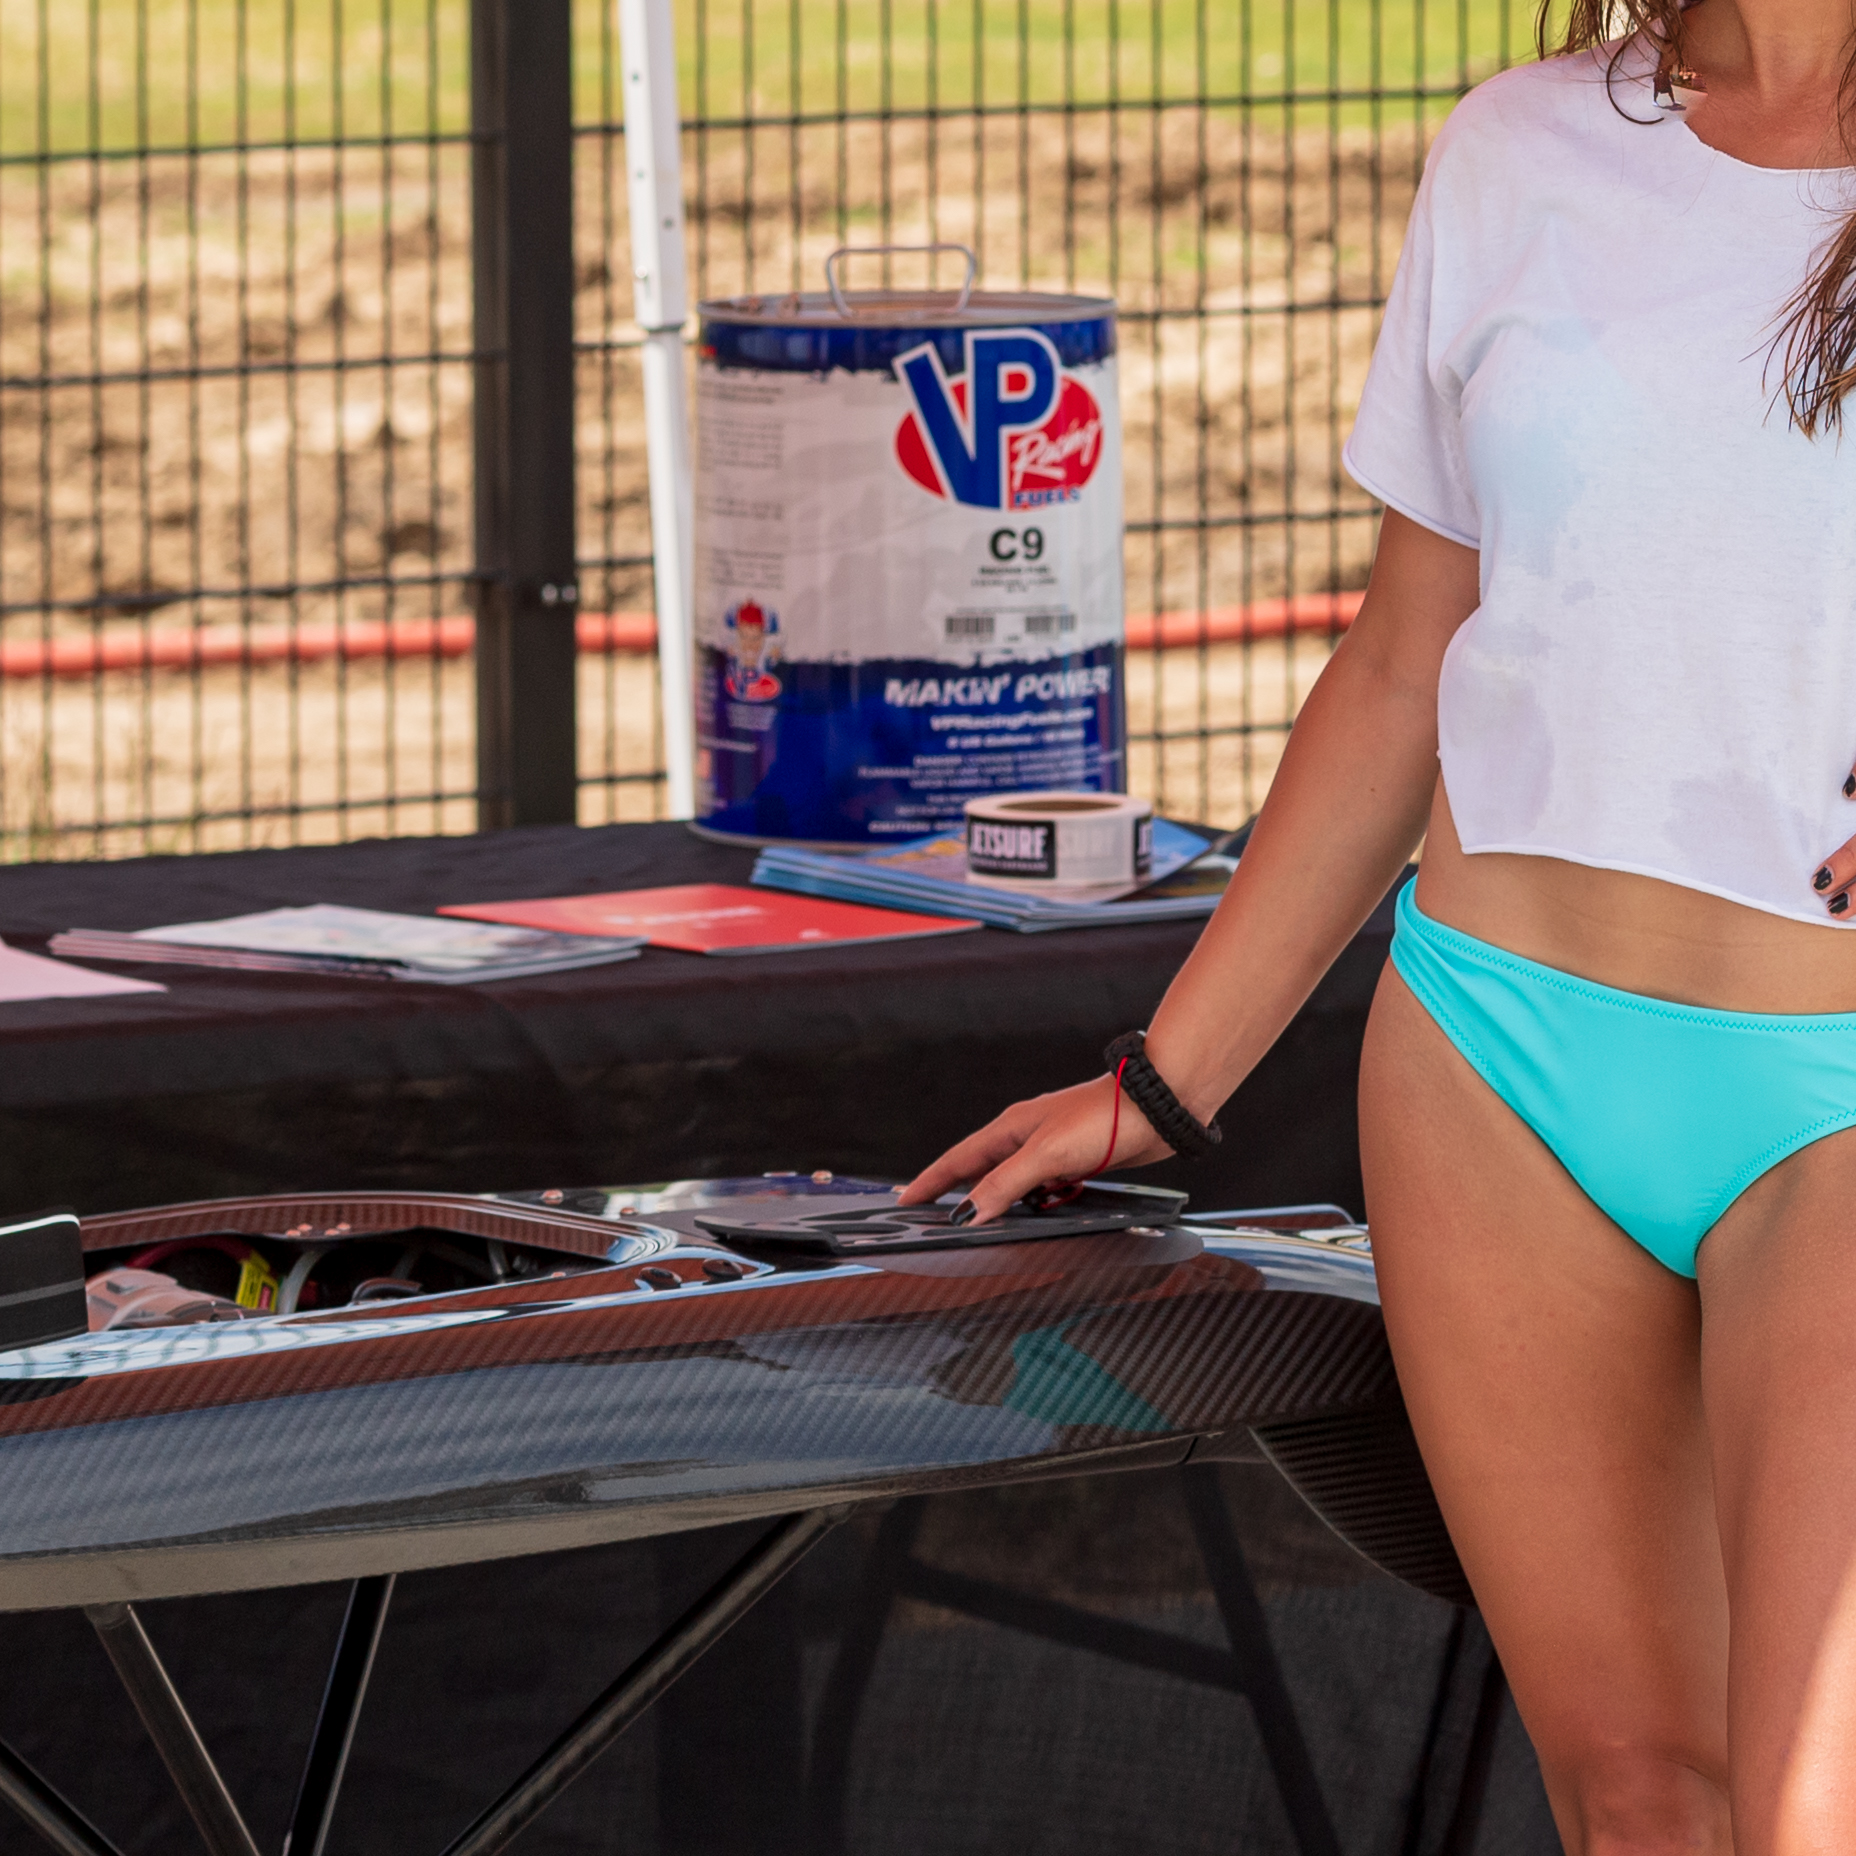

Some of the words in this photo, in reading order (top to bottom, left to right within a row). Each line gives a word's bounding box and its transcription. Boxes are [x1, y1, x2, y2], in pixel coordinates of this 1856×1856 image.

[893, 329, 1060, 511] VP
[1013, 488, 1081, 508] FUELS
[989, 527, 1045, 561] C9
[1013, 665, 1111, 702] POWER
[970, 822, 1049, 860] JETSURF
